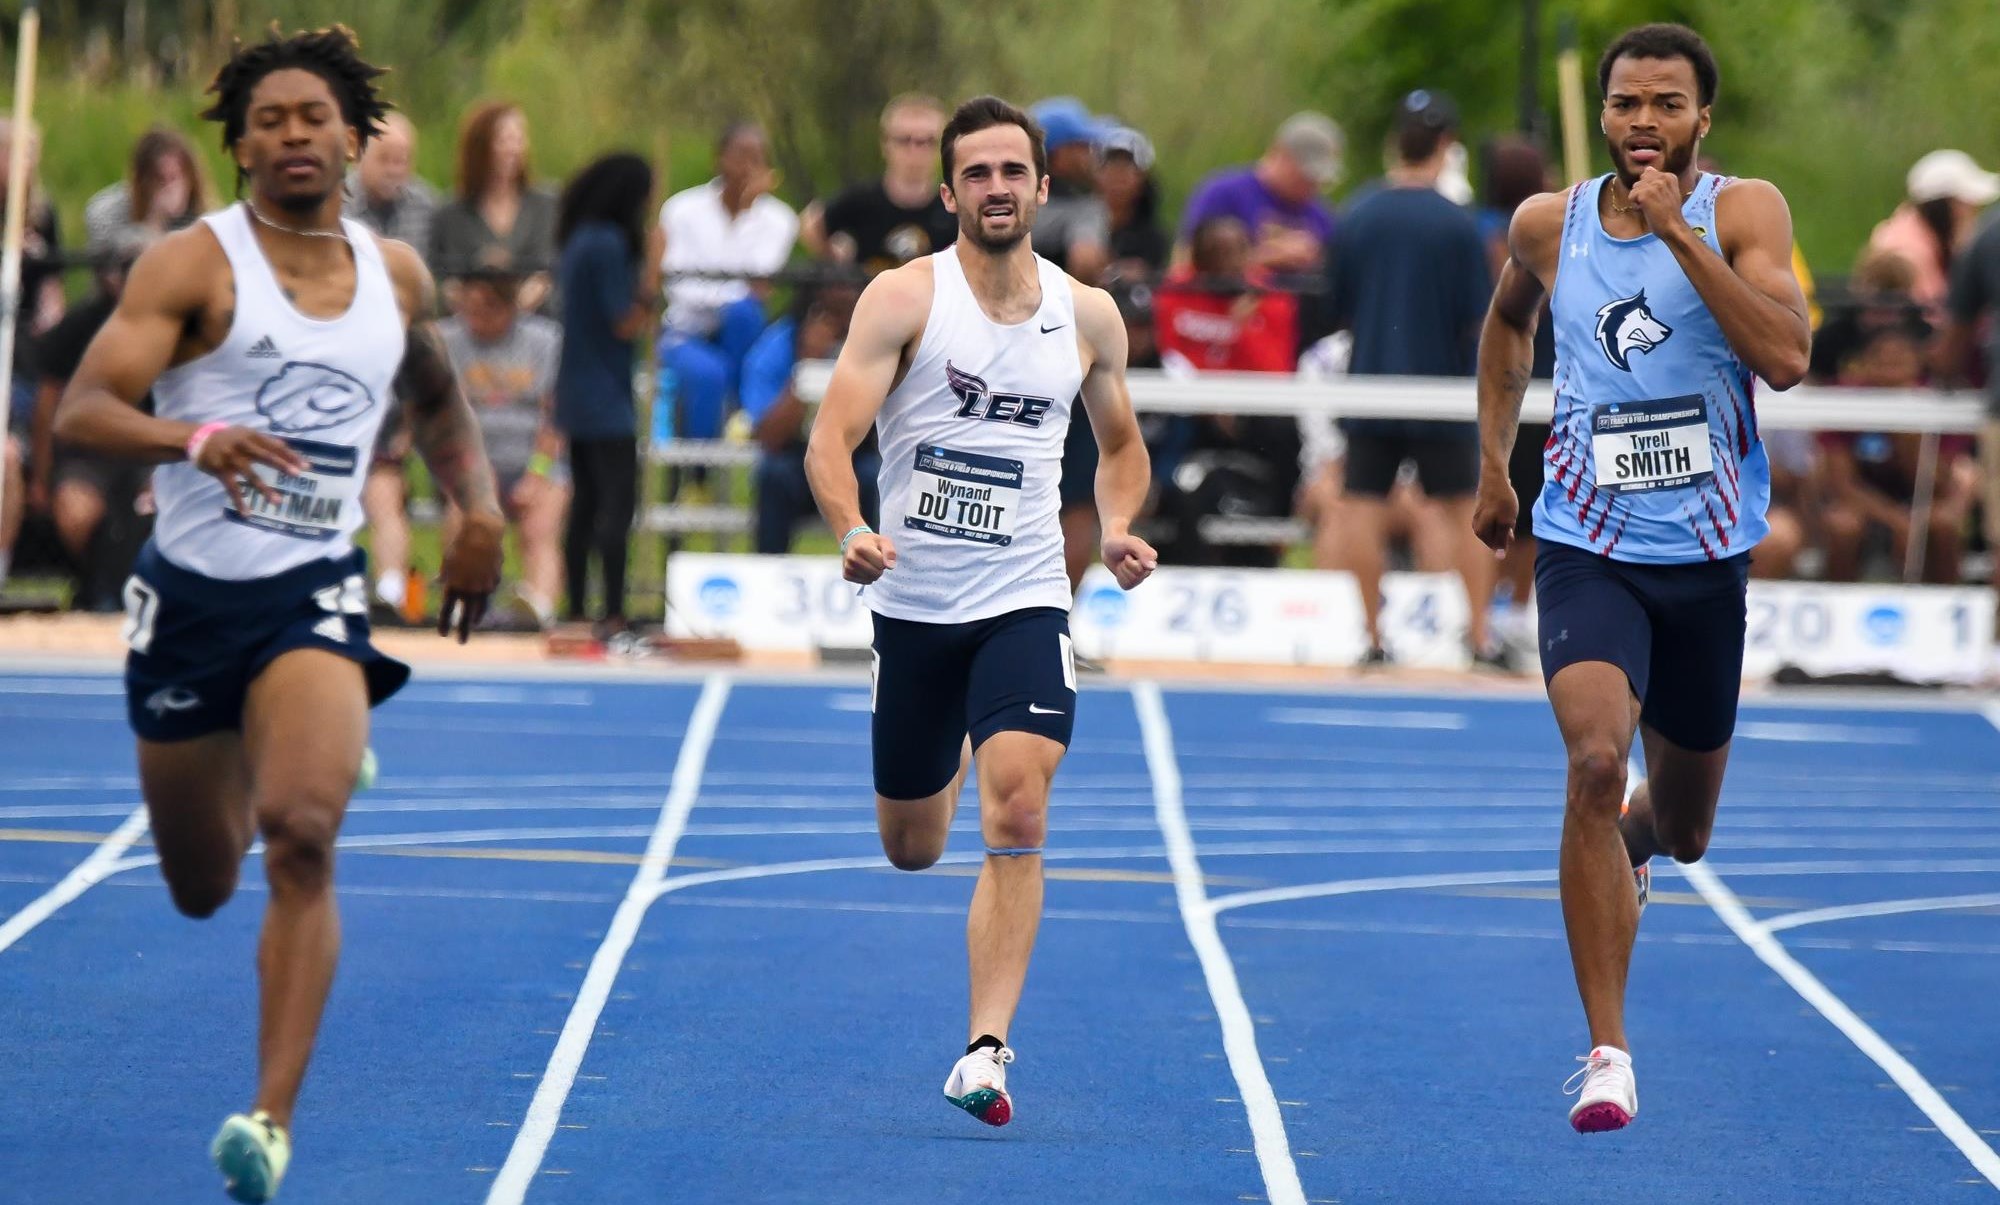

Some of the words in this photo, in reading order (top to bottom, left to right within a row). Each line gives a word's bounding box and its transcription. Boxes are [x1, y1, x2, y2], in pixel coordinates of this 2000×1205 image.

[954, 390, 1054, 429] LEE
[1630, 431, 1670, 452] Tyrell
[1615, 446, 1691, 479] SMITH
[937, 478, 992, 501] Wynand
[918, 492, 950, 520] DU
[957, 500, 1005, 530] TOIT
[774, 575, 857, 624] 30
[1166, 584, 1250, 636] 26
[1748, 600, 1832, 648] 20
